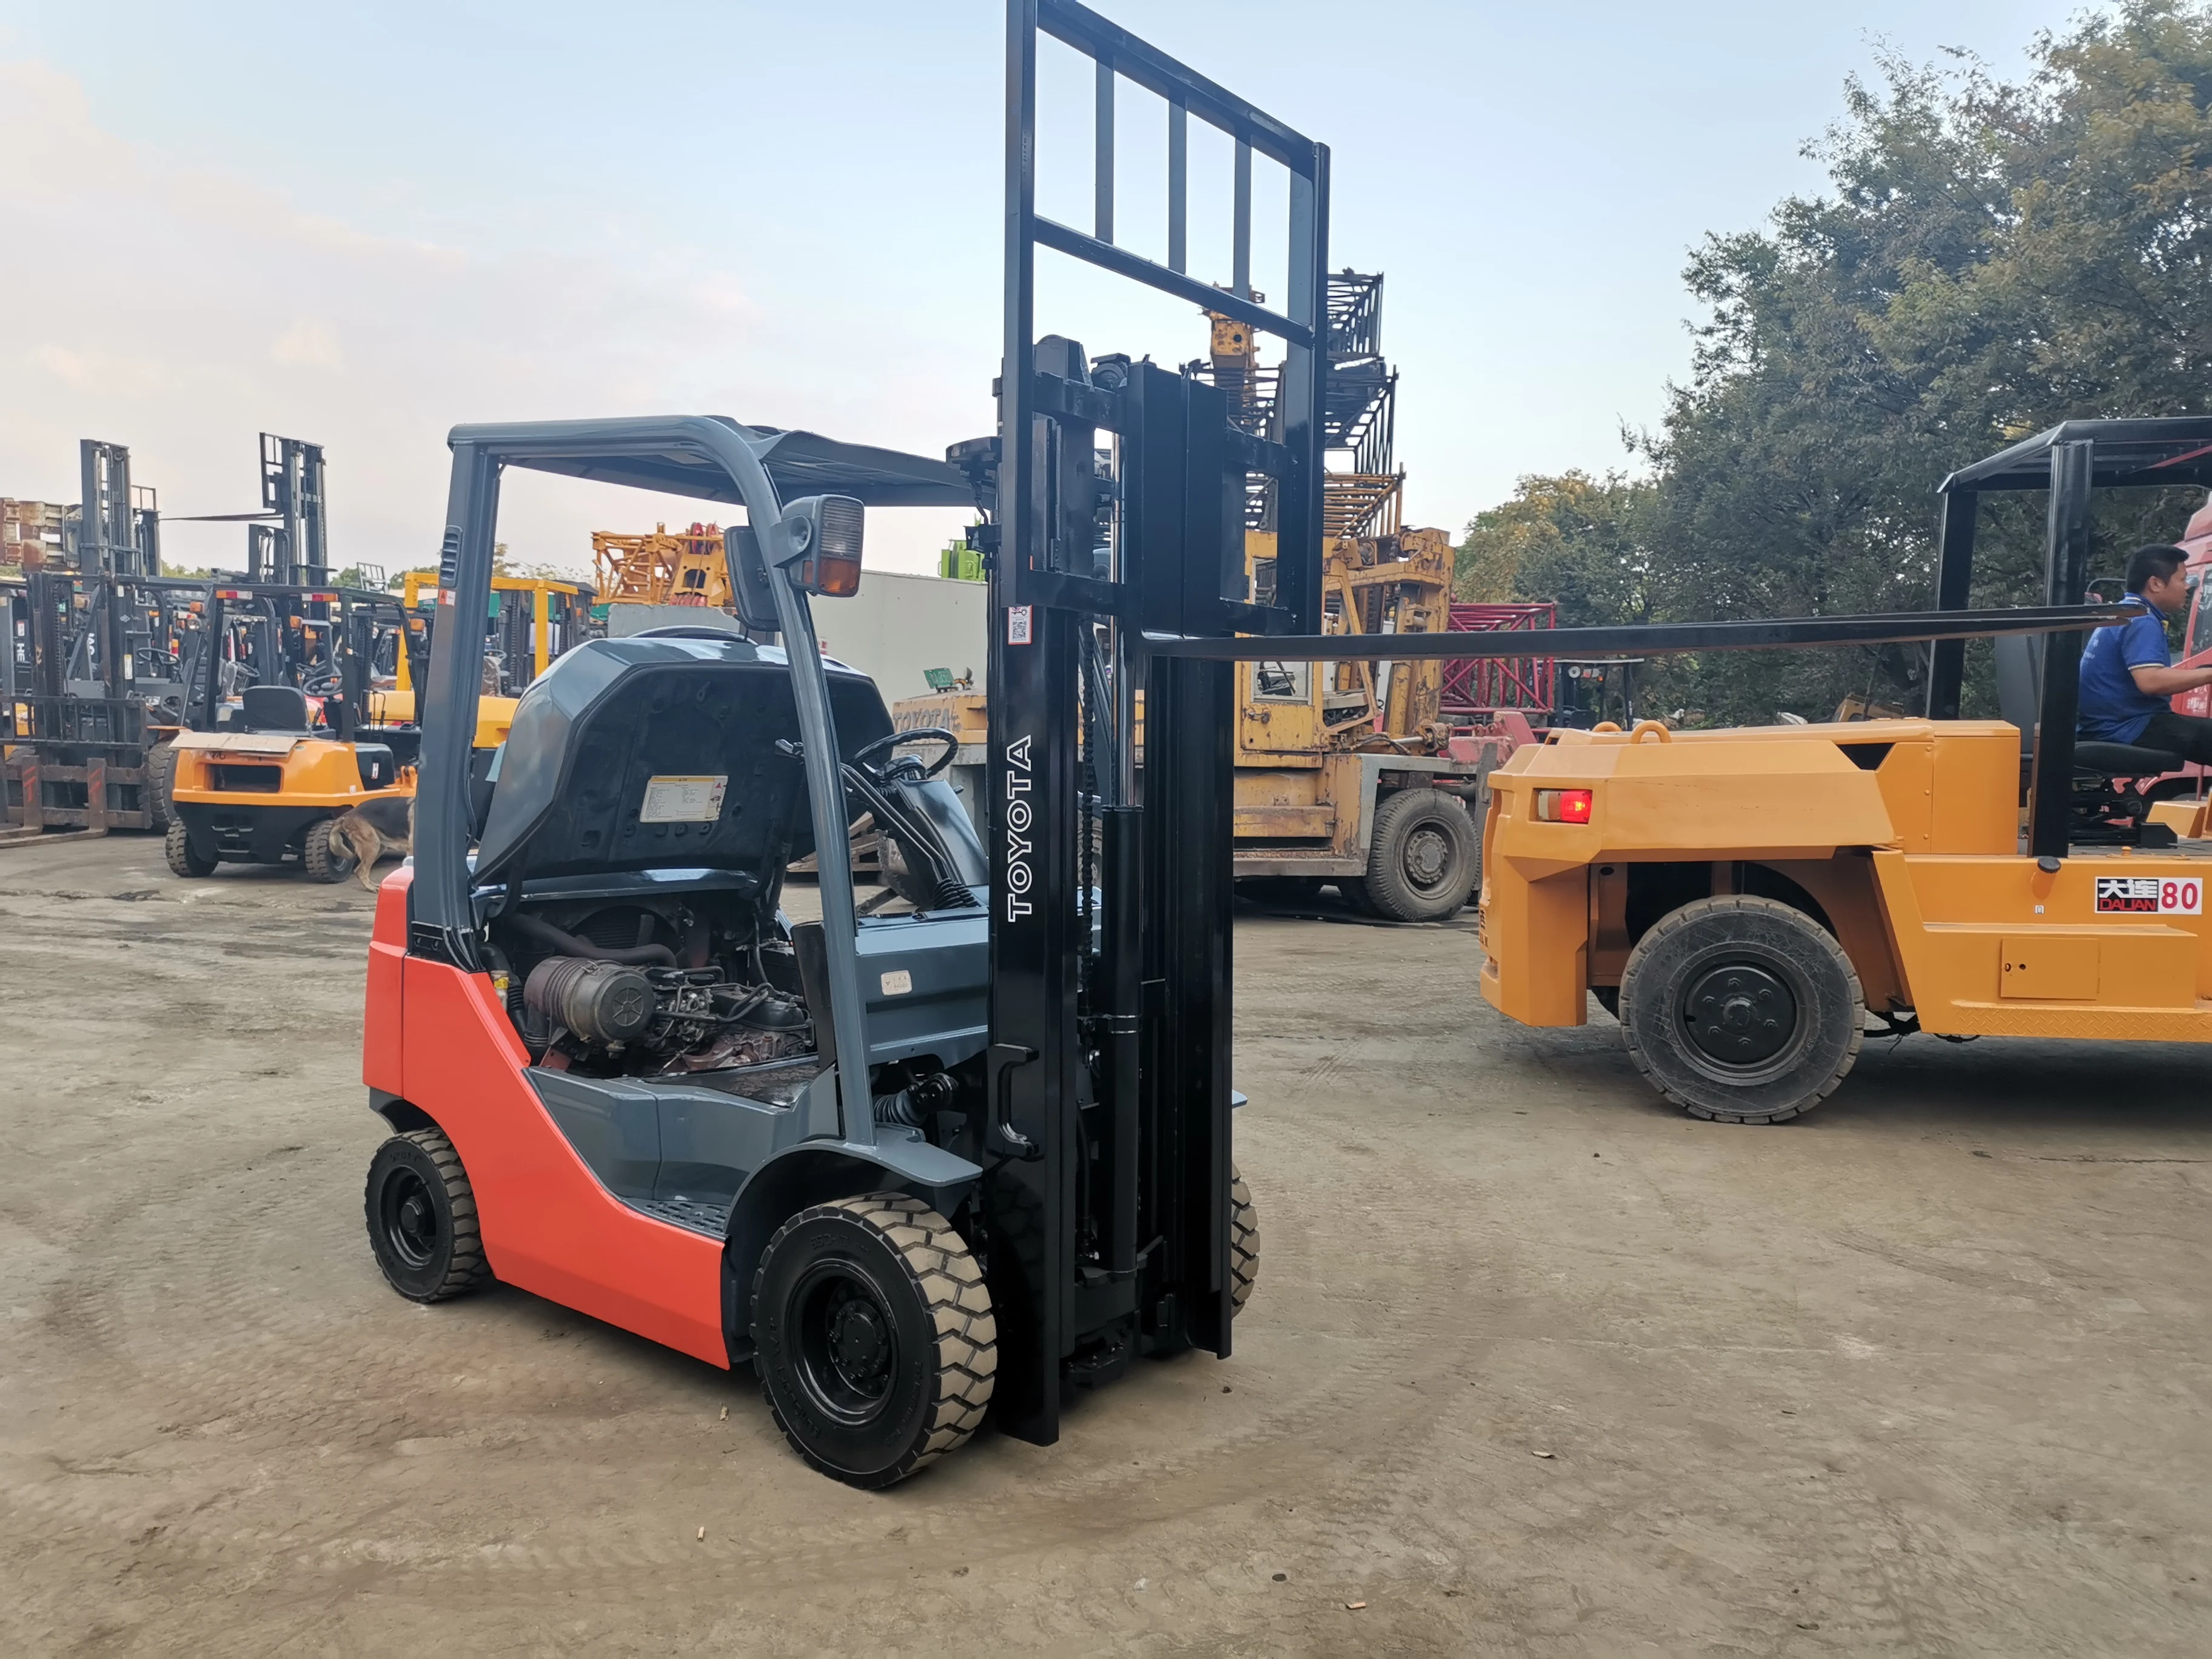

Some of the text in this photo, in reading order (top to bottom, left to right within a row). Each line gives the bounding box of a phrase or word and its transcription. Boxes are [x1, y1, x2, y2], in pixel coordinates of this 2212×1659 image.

[893, 708, 950, 734] TOYOTA
[1007, 734, 1032, 922] TOYOTA
[2099, 879, 2157, 899] 大连
[2161, 882, 2198, 910] 80
[2099, 899, 2156, 911] DALIAN
